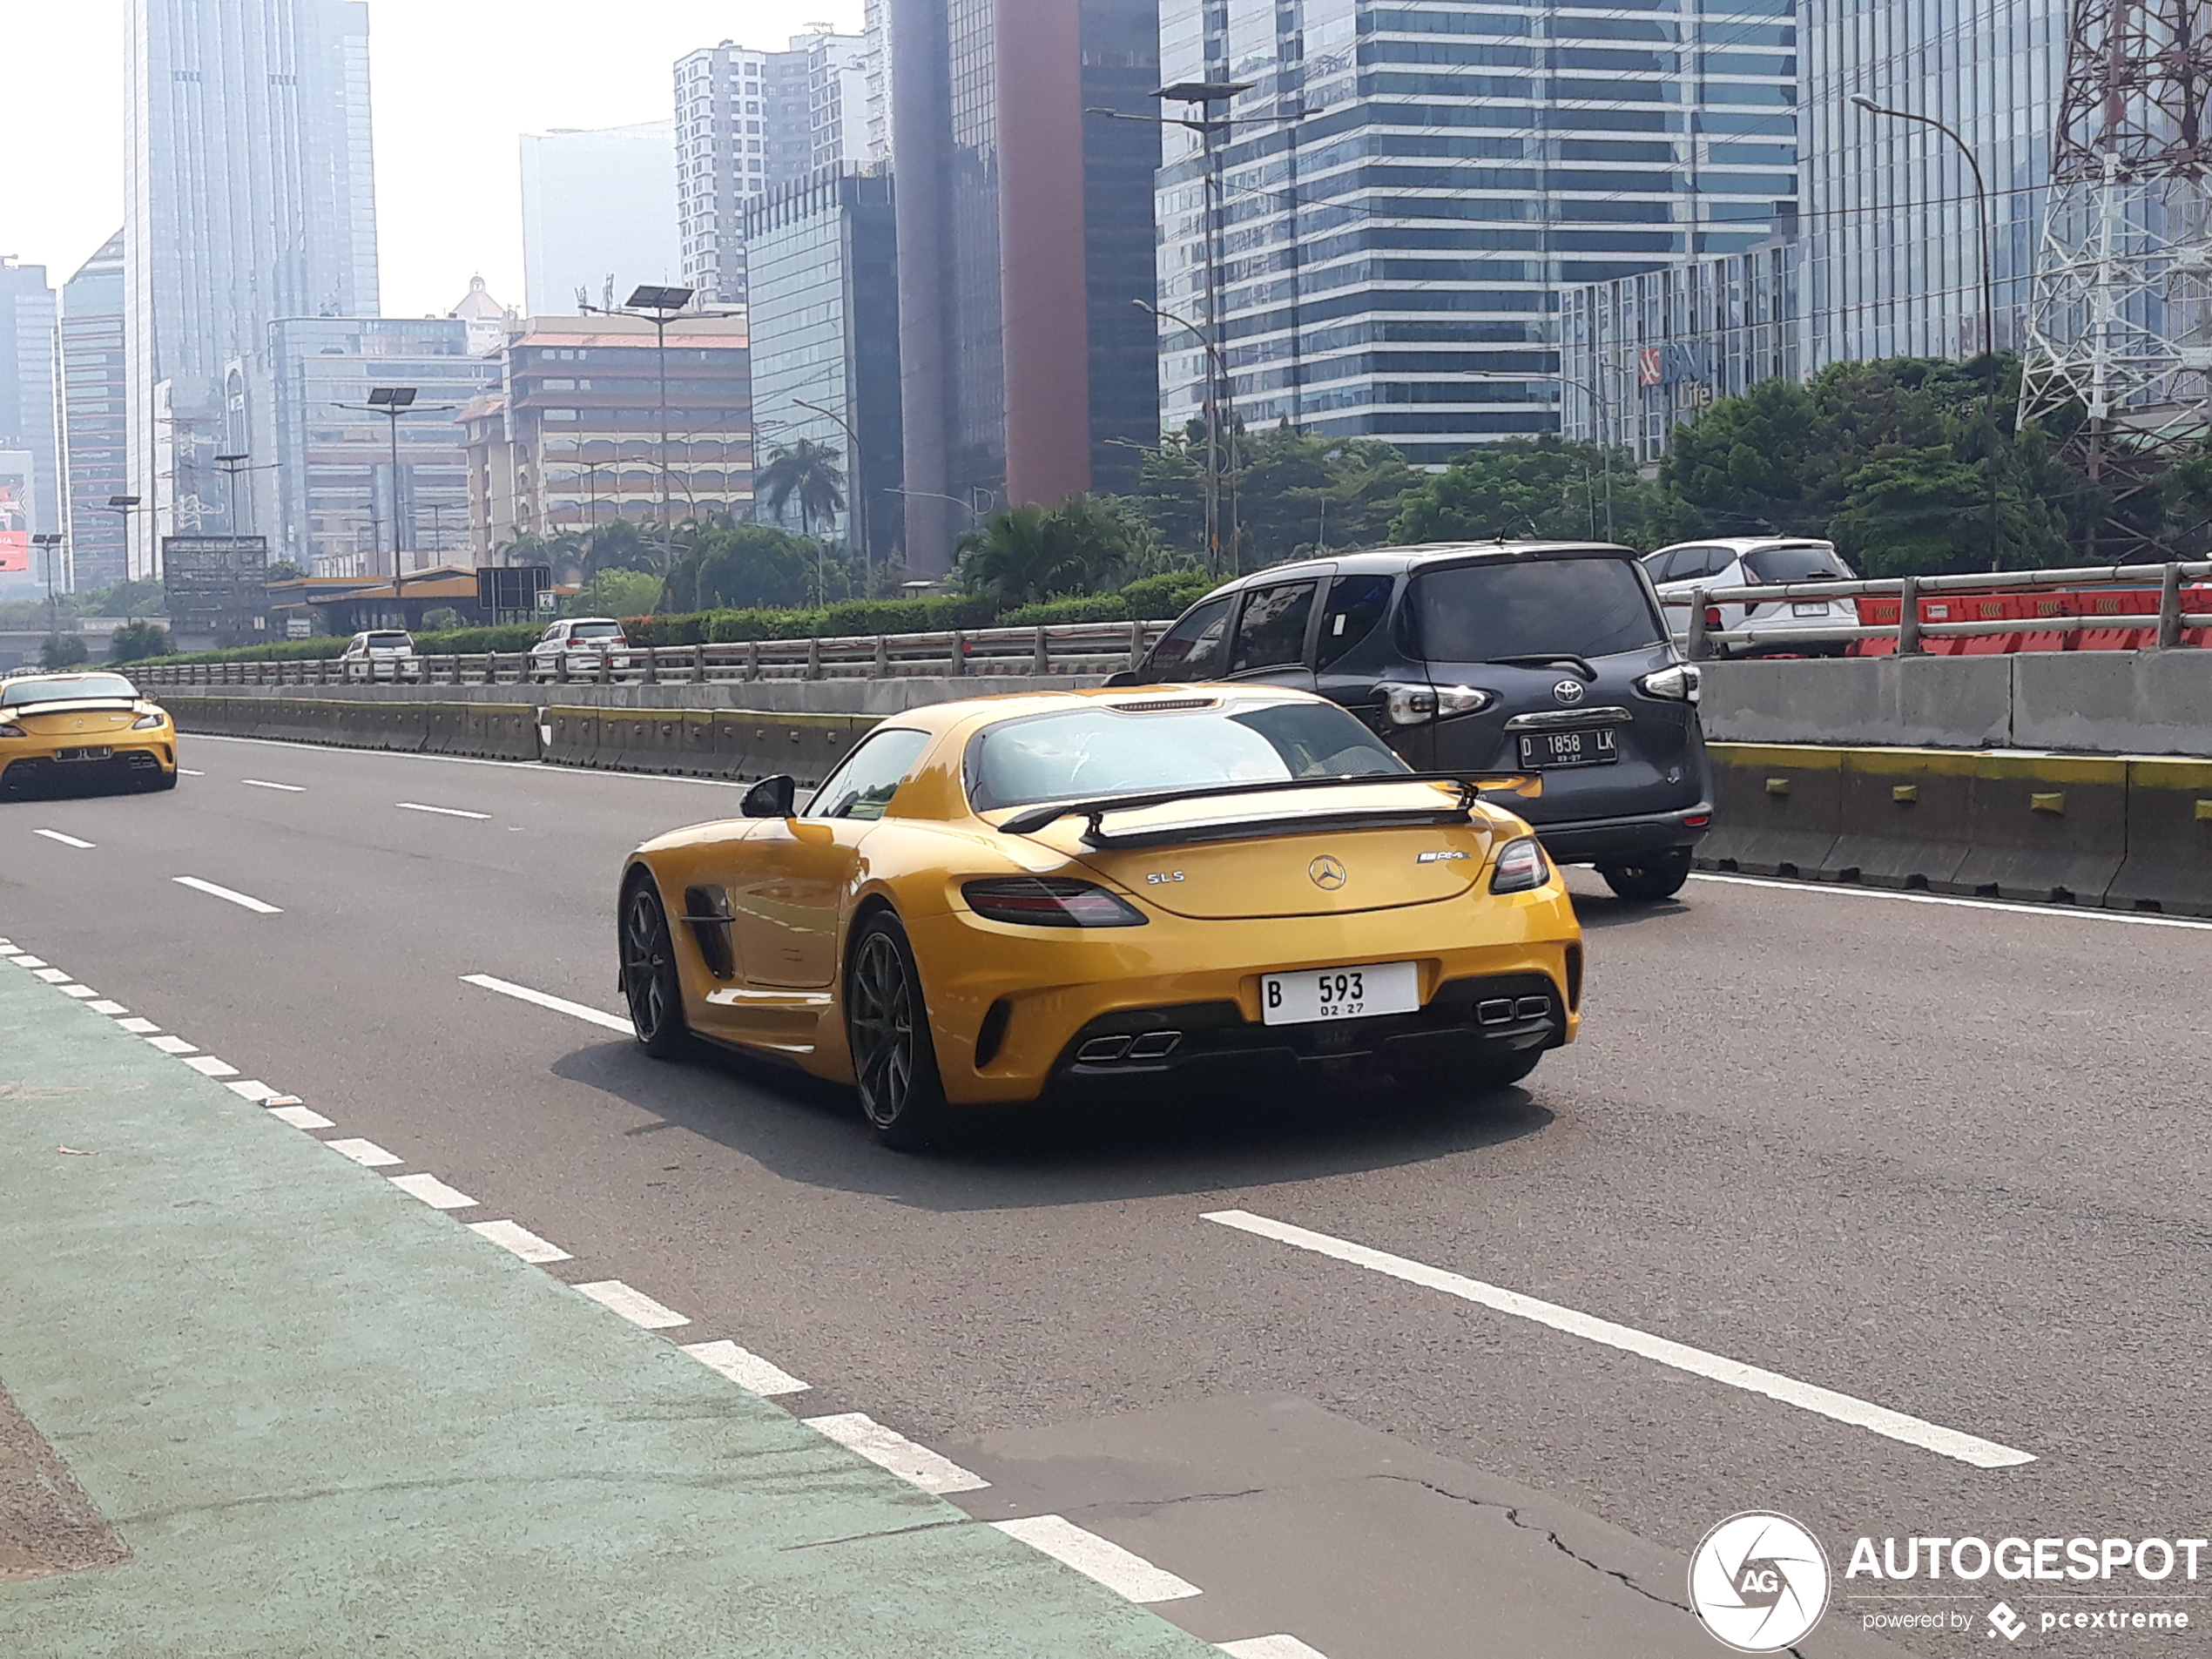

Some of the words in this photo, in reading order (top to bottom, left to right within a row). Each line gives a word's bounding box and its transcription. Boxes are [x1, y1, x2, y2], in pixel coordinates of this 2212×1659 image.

[1678, 381, 1711, 409] Life
[1522, 738, 1532, 757] D
[1548, 734, 1581, 754] 1858
[1596, 732, 1615, 750] LK
[1147, 871, 1185, 885] SLS
[1268, 981, 1282, 1008] B
[1318, 973, 1364, 1002] 593
